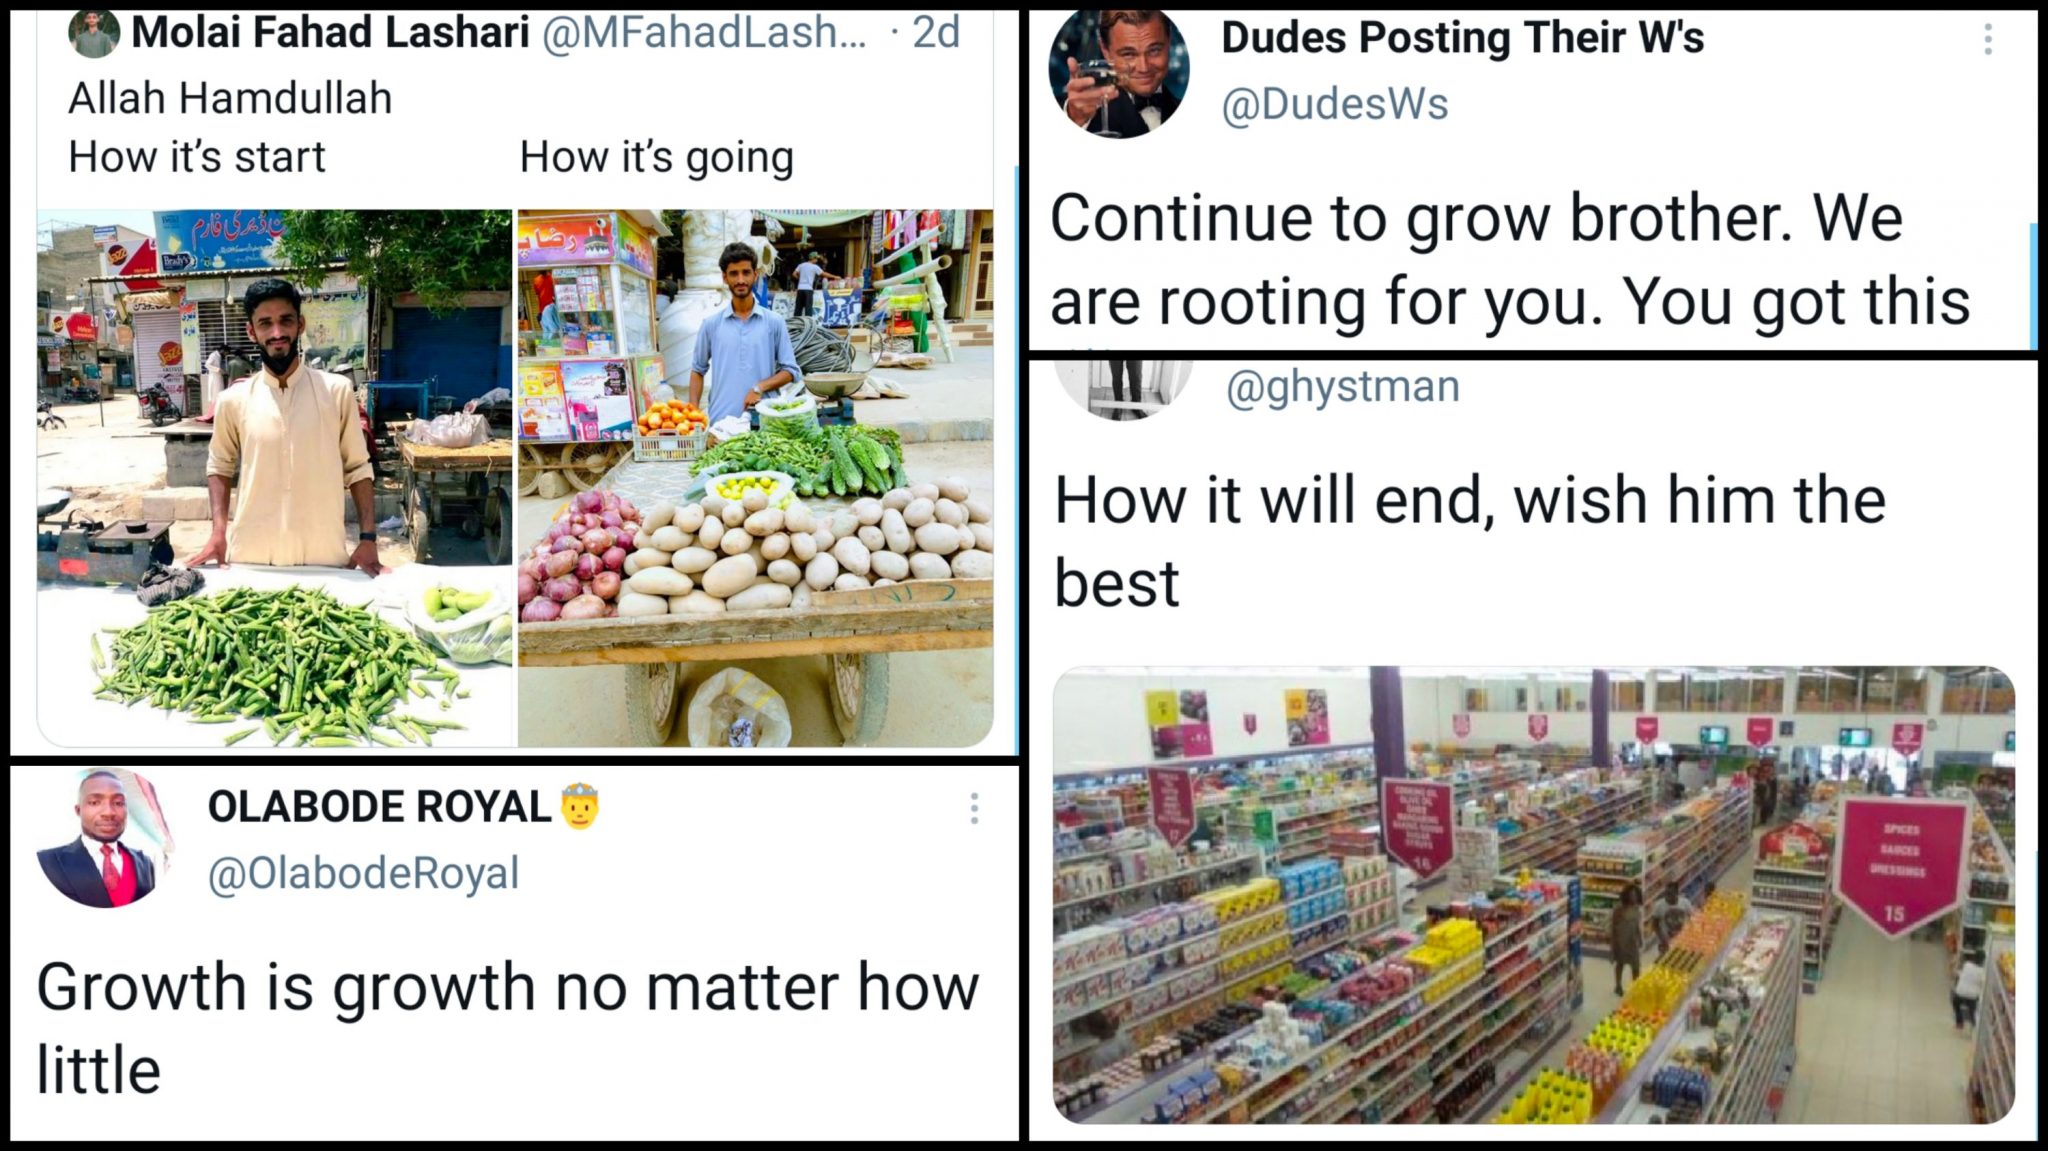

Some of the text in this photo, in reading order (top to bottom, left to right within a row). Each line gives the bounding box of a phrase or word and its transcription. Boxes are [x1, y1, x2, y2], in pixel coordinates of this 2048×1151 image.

[1883, 823, 1920, 836] SPICES
[1880, 844, 1920, 857] SAUCES
[1869, 863, 1927, 878] DRESSINGS
[1884, 905, 1905, 922] 15
